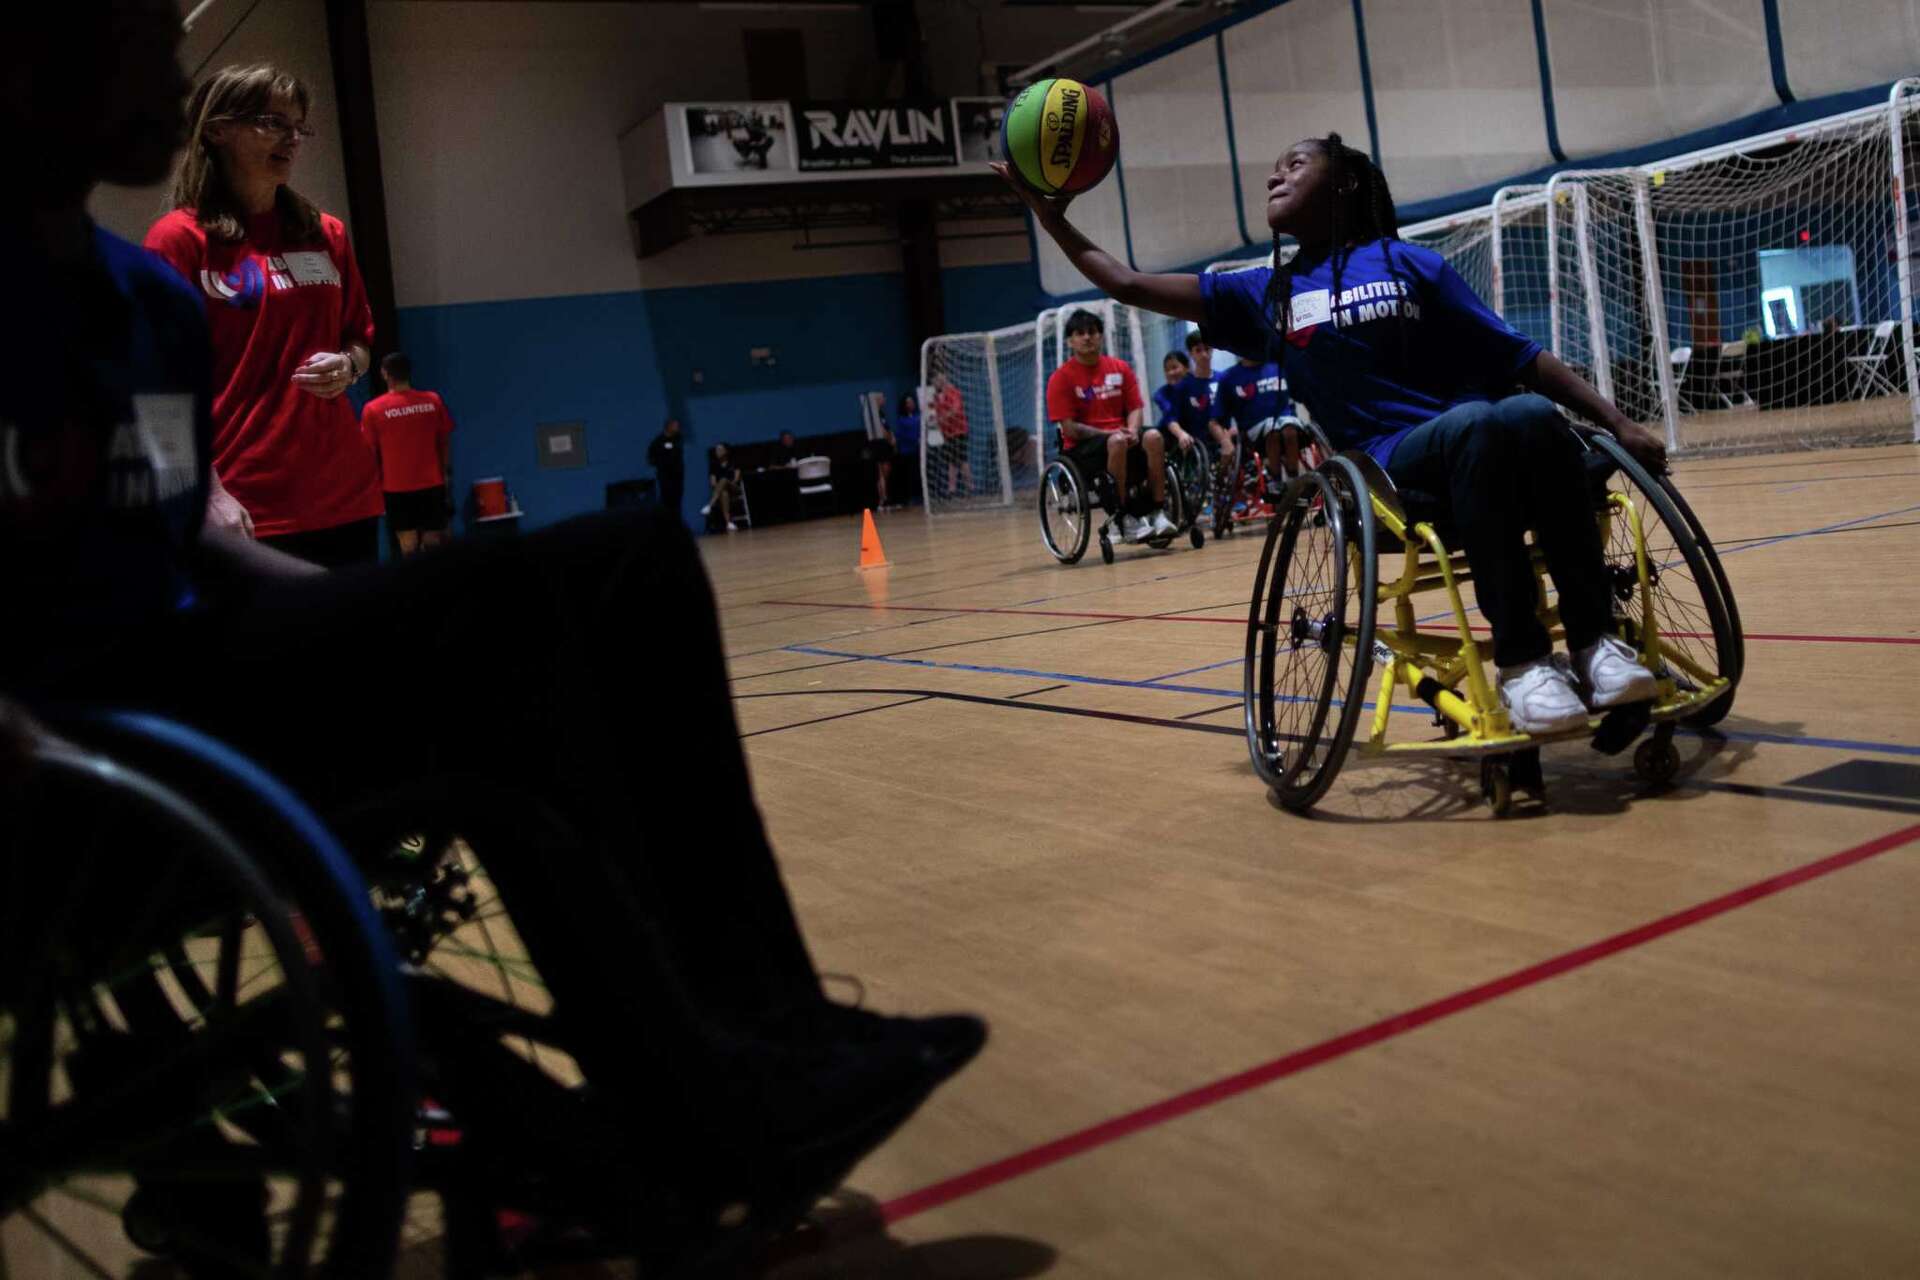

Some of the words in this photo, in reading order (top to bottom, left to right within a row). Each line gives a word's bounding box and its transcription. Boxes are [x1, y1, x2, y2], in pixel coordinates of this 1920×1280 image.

[802, 105, 945, 152] RAVLIN
[1050, 88, 1082, 170] SPALDING
[1331, 308, 1354, 329] IN
[1358, 299, 1421, 323] MOTON
[384, 402, 436, 419] VOLUNTEER
